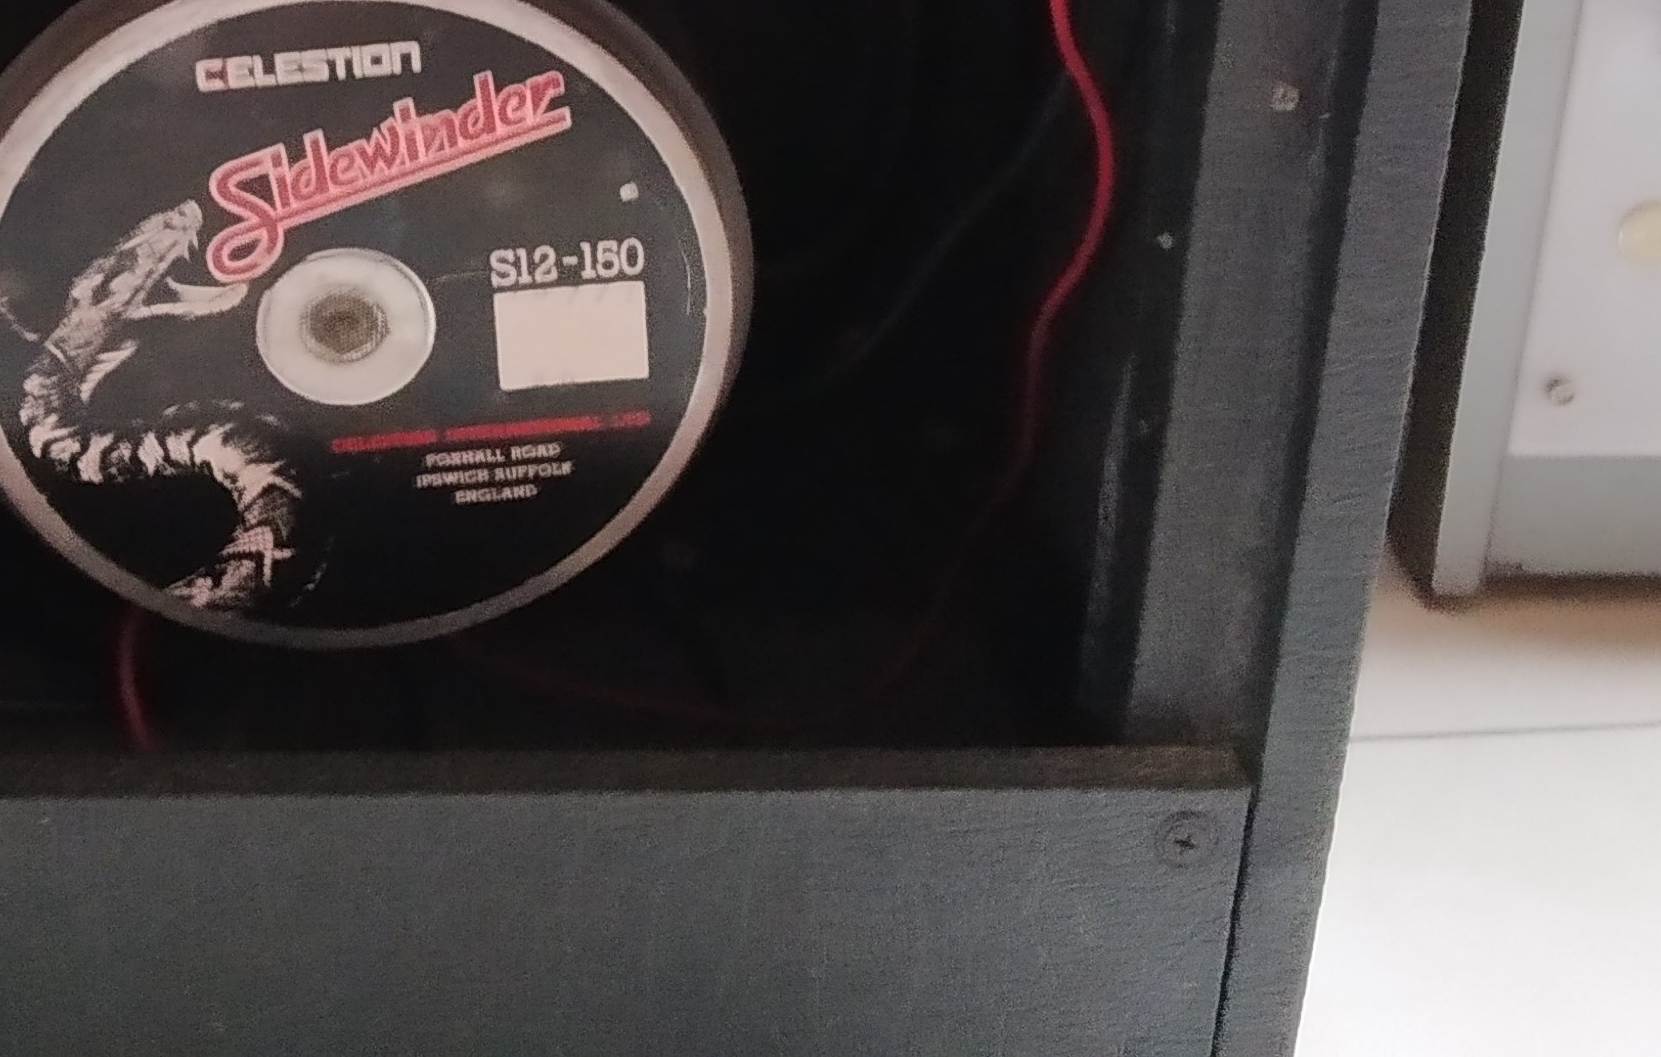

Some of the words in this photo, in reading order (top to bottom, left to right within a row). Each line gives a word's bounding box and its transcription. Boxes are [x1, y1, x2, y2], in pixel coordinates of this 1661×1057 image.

[195, 40, 422, 92] CELESTION
[206, 69, 573, 285] Sidewinder
[490, 237, 646, 289] S12-150
[510, 442, 562, 460] ROAD
[454, 483, 540, 505] ENGLAND
